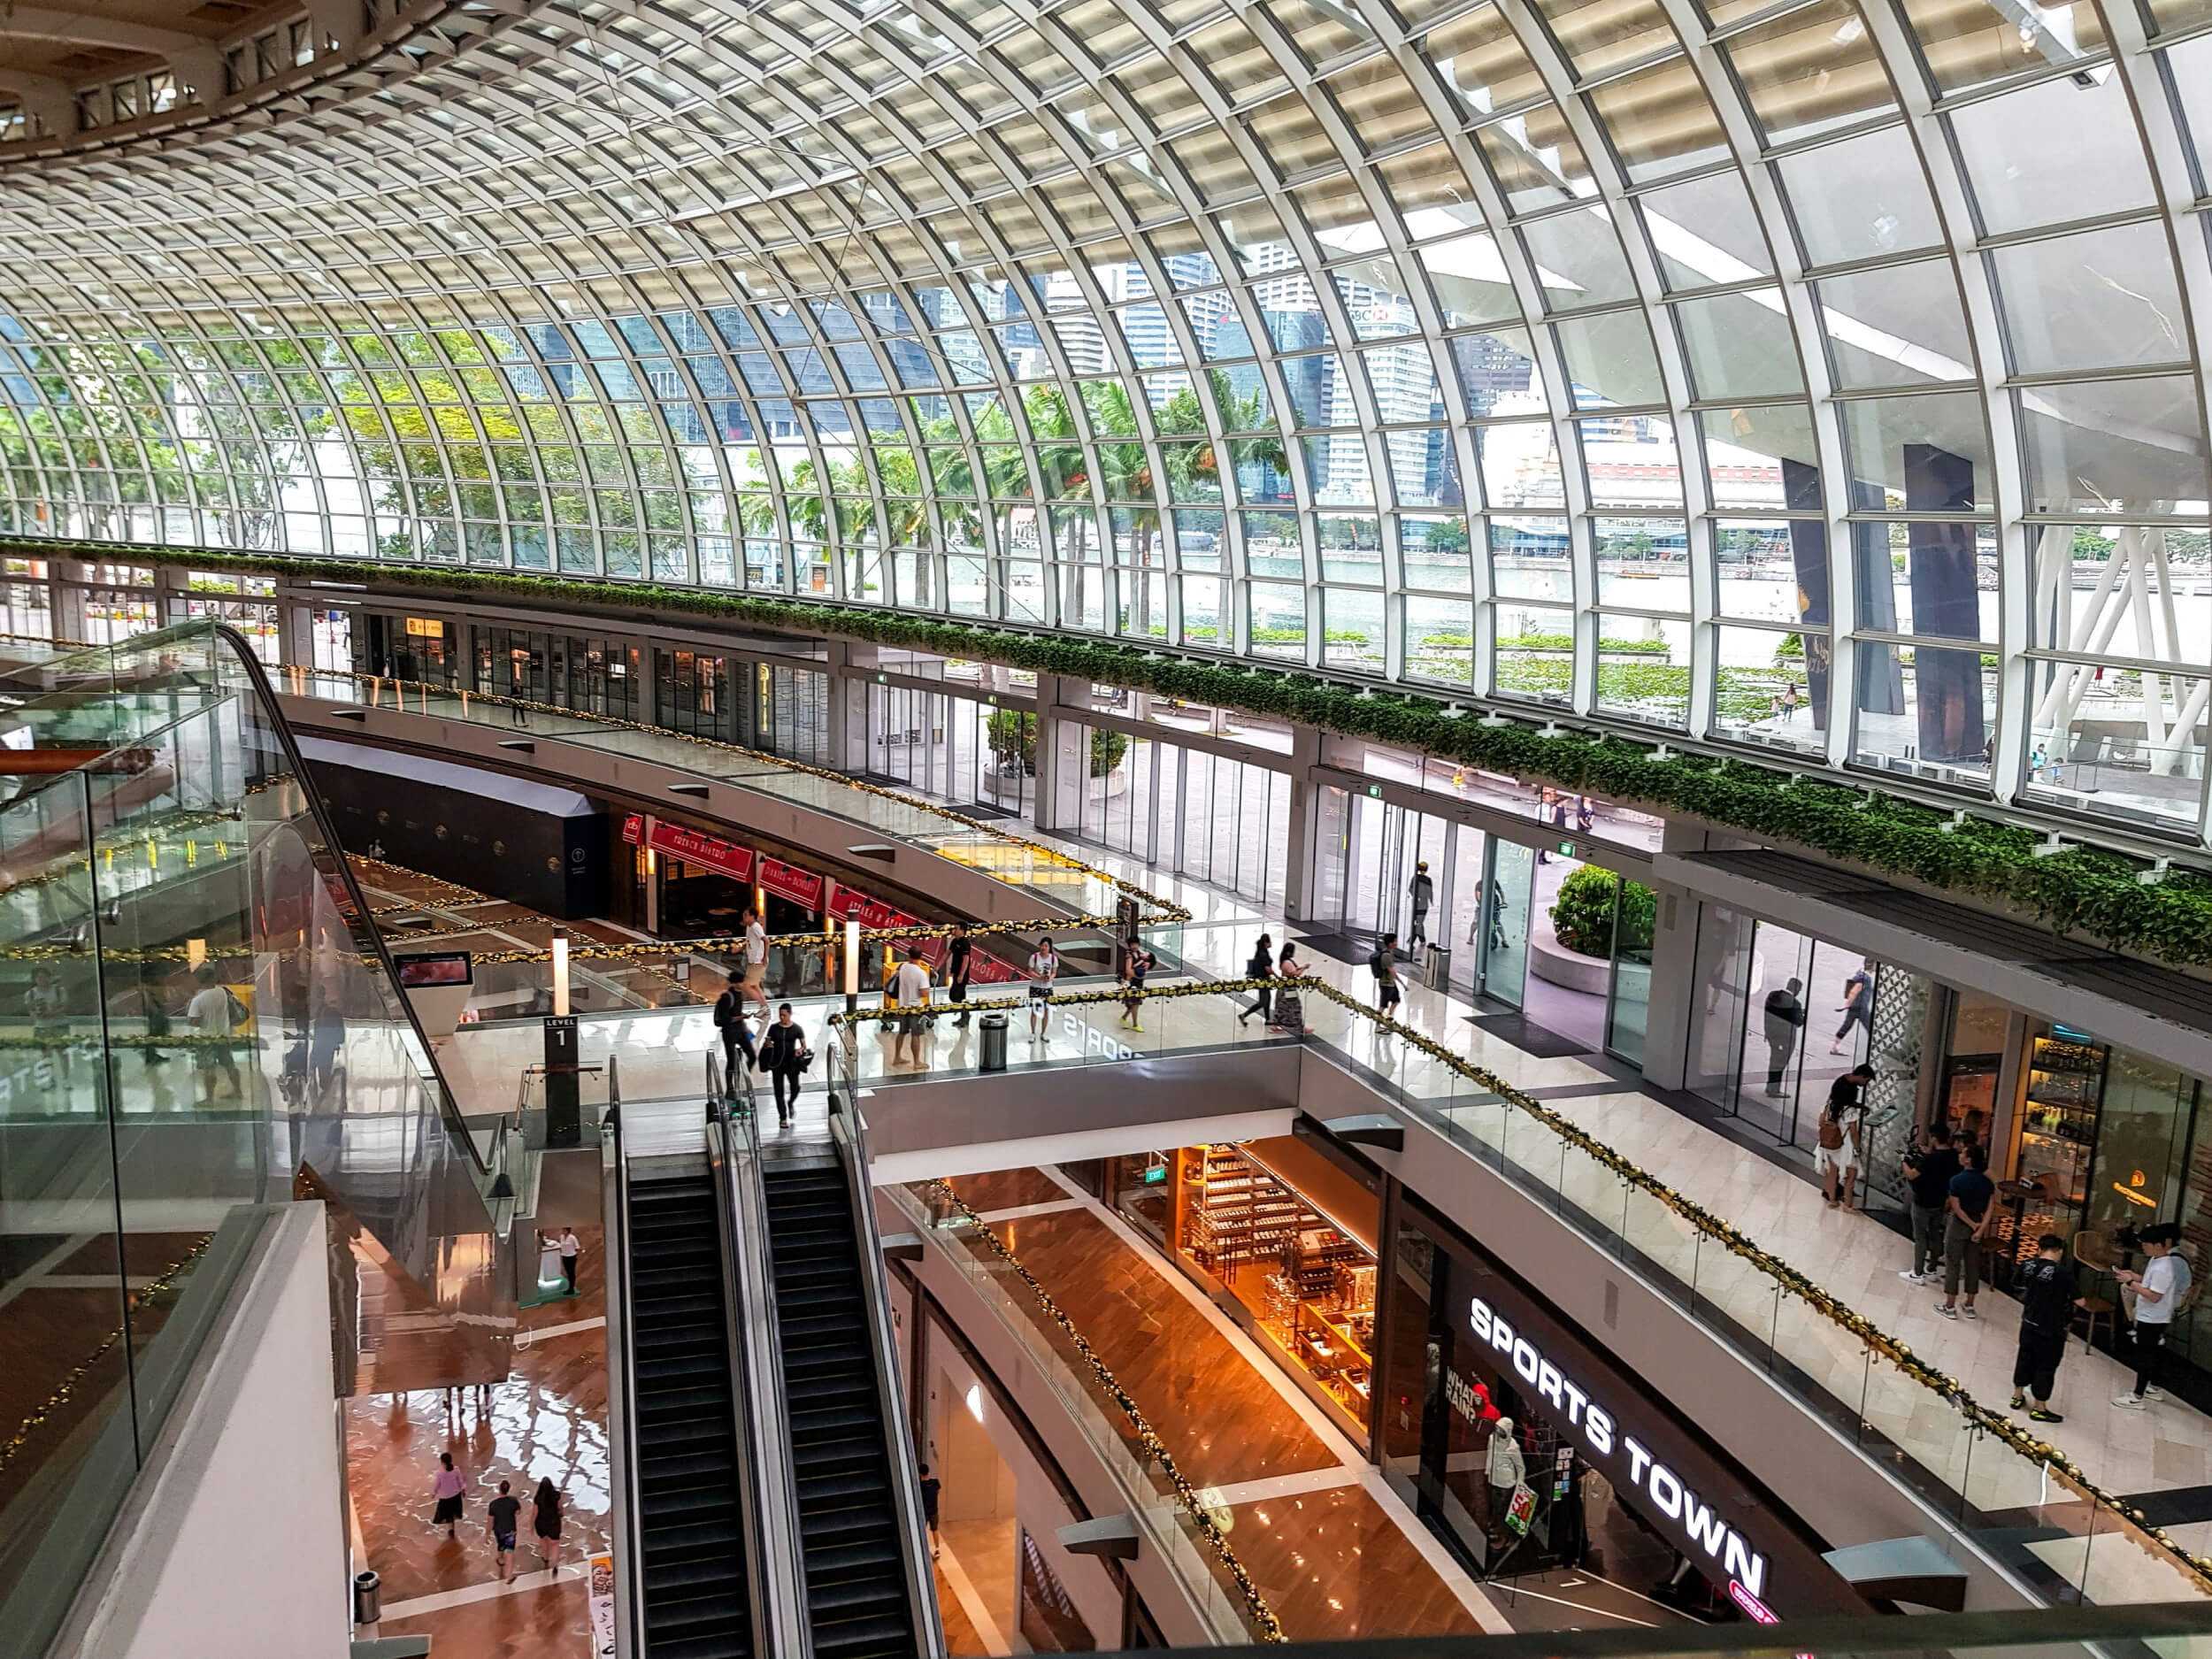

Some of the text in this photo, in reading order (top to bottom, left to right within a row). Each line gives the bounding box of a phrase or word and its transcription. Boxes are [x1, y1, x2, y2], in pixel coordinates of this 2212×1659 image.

[556, 1029, 565, 1046] 1
[1445, 1381, 1476, 1425] RAIN?
[1470, 1297, 1765, 1599] SPORTS TOWN
